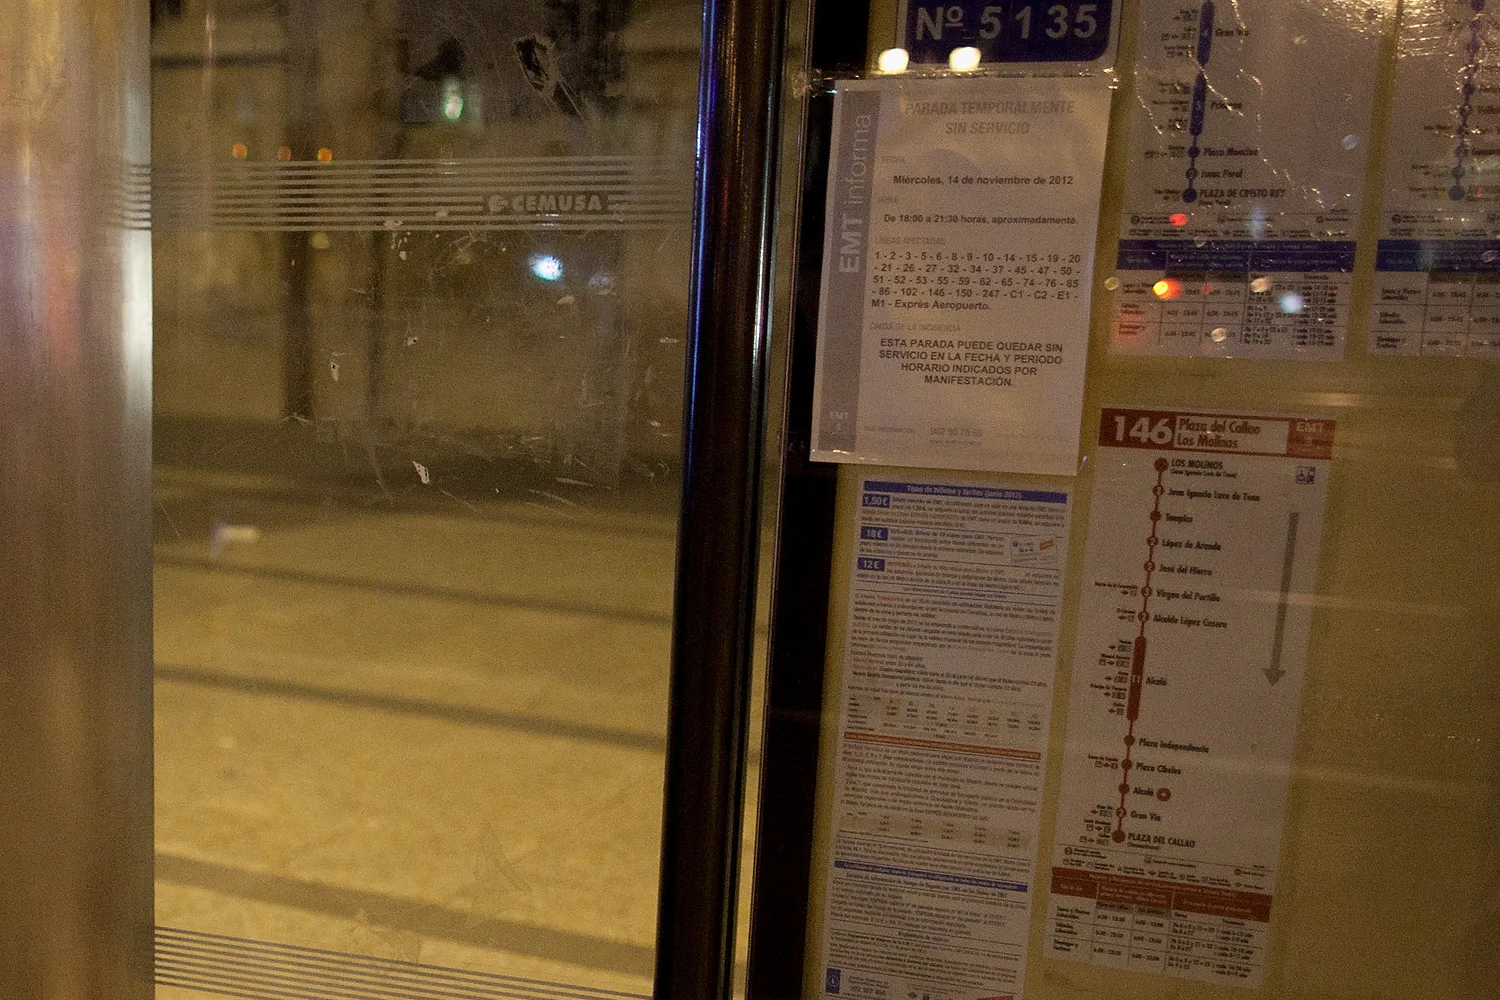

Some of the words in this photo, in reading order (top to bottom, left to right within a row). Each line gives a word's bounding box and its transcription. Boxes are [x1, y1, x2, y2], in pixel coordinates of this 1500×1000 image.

[916, 6, 963, 40] Nº
[906, 101, 957, 115] PARADA
[962, 100, 1074, 115] TEMPORALMENTE
[946, 122, 966, 135] SIN
[970, 122, 1029, 135] SERVICIO
[948, 175, 959, 184] 14
[962, 175, 974, 184] de
[976, 175, 1030, 184] noviembre
[1033, 175, 1046, 185] de
[1049, 176, 1073, 185] 2012
[840, 213, 860, 272] EMT
[850, 114, 871, 205] informa
[511, 195, 602, 211] CEMUSA
[884, 215, 895, 223] De
[900, 215, 923, 223] 18:00
[933, 215, 957, 223] 21:30
[875, 252, 880, 261] 1
[890, 252, 896, 261] 2
[905, 252, 911, 261] 3
[921, 253, 926, 261] 5
[936, 253, 942, 261] 6
[952, 253, 957, 261] 8
[967, 253, 972, 262] 9
[983, 253, 994, 262] 10
[1005, 254, 1016, 262] 14
[1026, 254, 1037, 262] 15
[1047, 254, 1058, 263] 19
[1068, 255, 1081, 263] 20
[881, 264, 892, 272] 21
[903, 264, 914, 273] 26
[925, 264, 937, 273] 27
[947, 265, 960, 274] 32
[970, 265, 982, 274] 34
[992, 266, 1004, 274] 37
[1014, 266, 1027, 275] 45
[1037, 266, 1049, 275] 47
[1060, 267, 1072, 275] 50
[873, 275, 884, 284] 51
[894, 276, 906, 284] 52
[915, 276, 927, 285] 53
[937, 277, 949, 285] 55
[958, 277, 970, 286] 59
[979, 278, 991, 286] 62
[1001, 278, 1013, 287] 65
[1023, 278, 1035, 287] 74
[1045, 279, 1057, 288] 76
[1066, 279, 1079, 288] 85
[878, 288, 890, 297] 86
[900, 288, 918, 297] 102
[928, 289, 945, 298] 146
[955, 289, 972, 298] 150
[982, 290, 999, 299] 247
[1009, 290, 1023, 299] C1
[1034, 291, 1048, 300] C2
[1057, 291, 1071, 300] E1
[871, 300, 885, 308] M1
[880, 338, 907, 347] ESTA
[910, 339, 954, 349] PARADA
[957, 340, 993, 349] PUEDE
[996, 342, 1042, 351] QUEDAR
[1045, 343, 1063, 352] SIN
[879, 350, 927, 360] SERVICIO
[930, 352, 944, 361] EN
[948, 352, 961, 361] LA
[964, 353, 1000, 362] FECHA
[1004, 354, 1010, 362] Y
[1014, 355, 1062, 364] PERIODO
[901, 363, 949, 372] HORARIO
[952, 364, 1011, 374] INDICADOS
[1014, 366, 1037, 375] POR
[1113, 415, 1173, 445] 146
[1178, 418, 1210, 432] Plaza
[1212, 420, 1227, 433] del
[1229, 422, 1261, 435] Callao
[1177, 434, 1195, 446] Los
[1197, 435, 1238, 449] Molinos
[1171, 459, 1187, 467] LOS
[1189, 460, 1223, 469] MOLINOS
[863, 560, 880, 569] 12€
